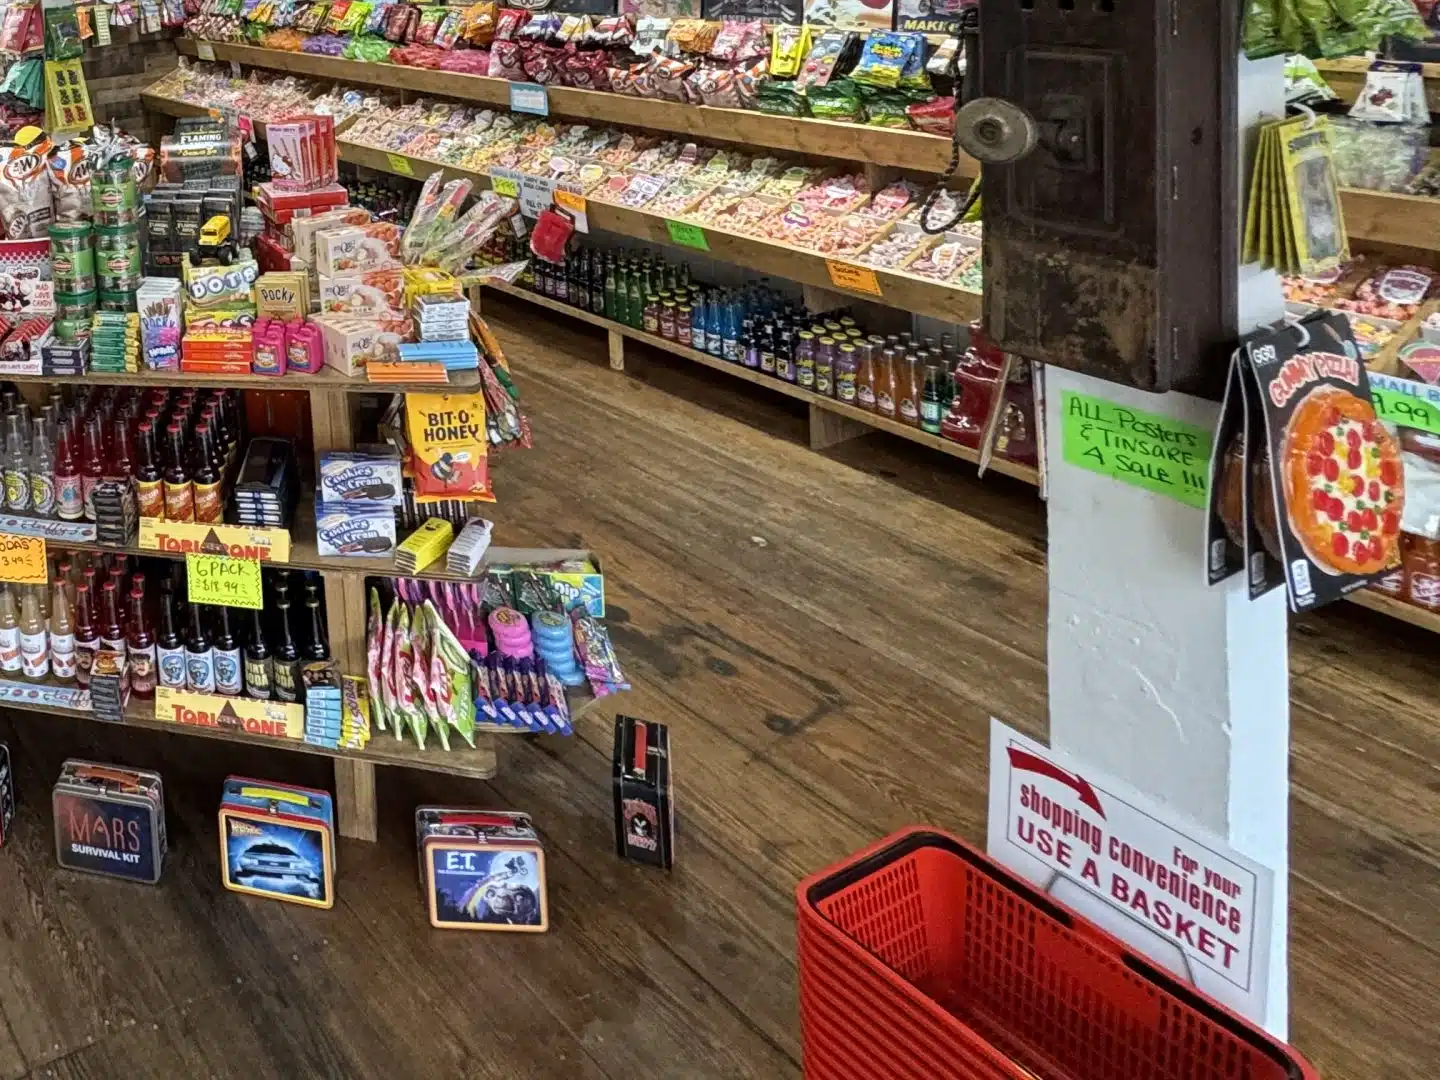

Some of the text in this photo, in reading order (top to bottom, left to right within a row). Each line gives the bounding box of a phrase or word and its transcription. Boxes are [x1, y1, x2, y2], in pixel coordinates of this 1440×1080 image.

[181, 133, 222, 144] FLAMING
[190, 265, 258, 299] DOTS
[1370, 376, 1418, 398] MALL
[1069, 396, 1113, 423] ALL
[424, 424, 483, 443] HONEY
[323, 465, 374, 488] Cookies
[347, 476, 383, 491] Cream
[319, 519, 370, 542] Cookies
[343, 530, 379, 544] Cream
[196, 562, 250, 577] 6 PACK
[69, 809, 141, 852] MARS
[71, 842, 141, 864] SURVIVAL KIT
[446, 850, 477, 871] E.T.
[1020, 782, 1242, 936] shopping convenience
[1173, 845, 1241, 901] For your
[1016, 815, 1240, 970] USE A BASKET
